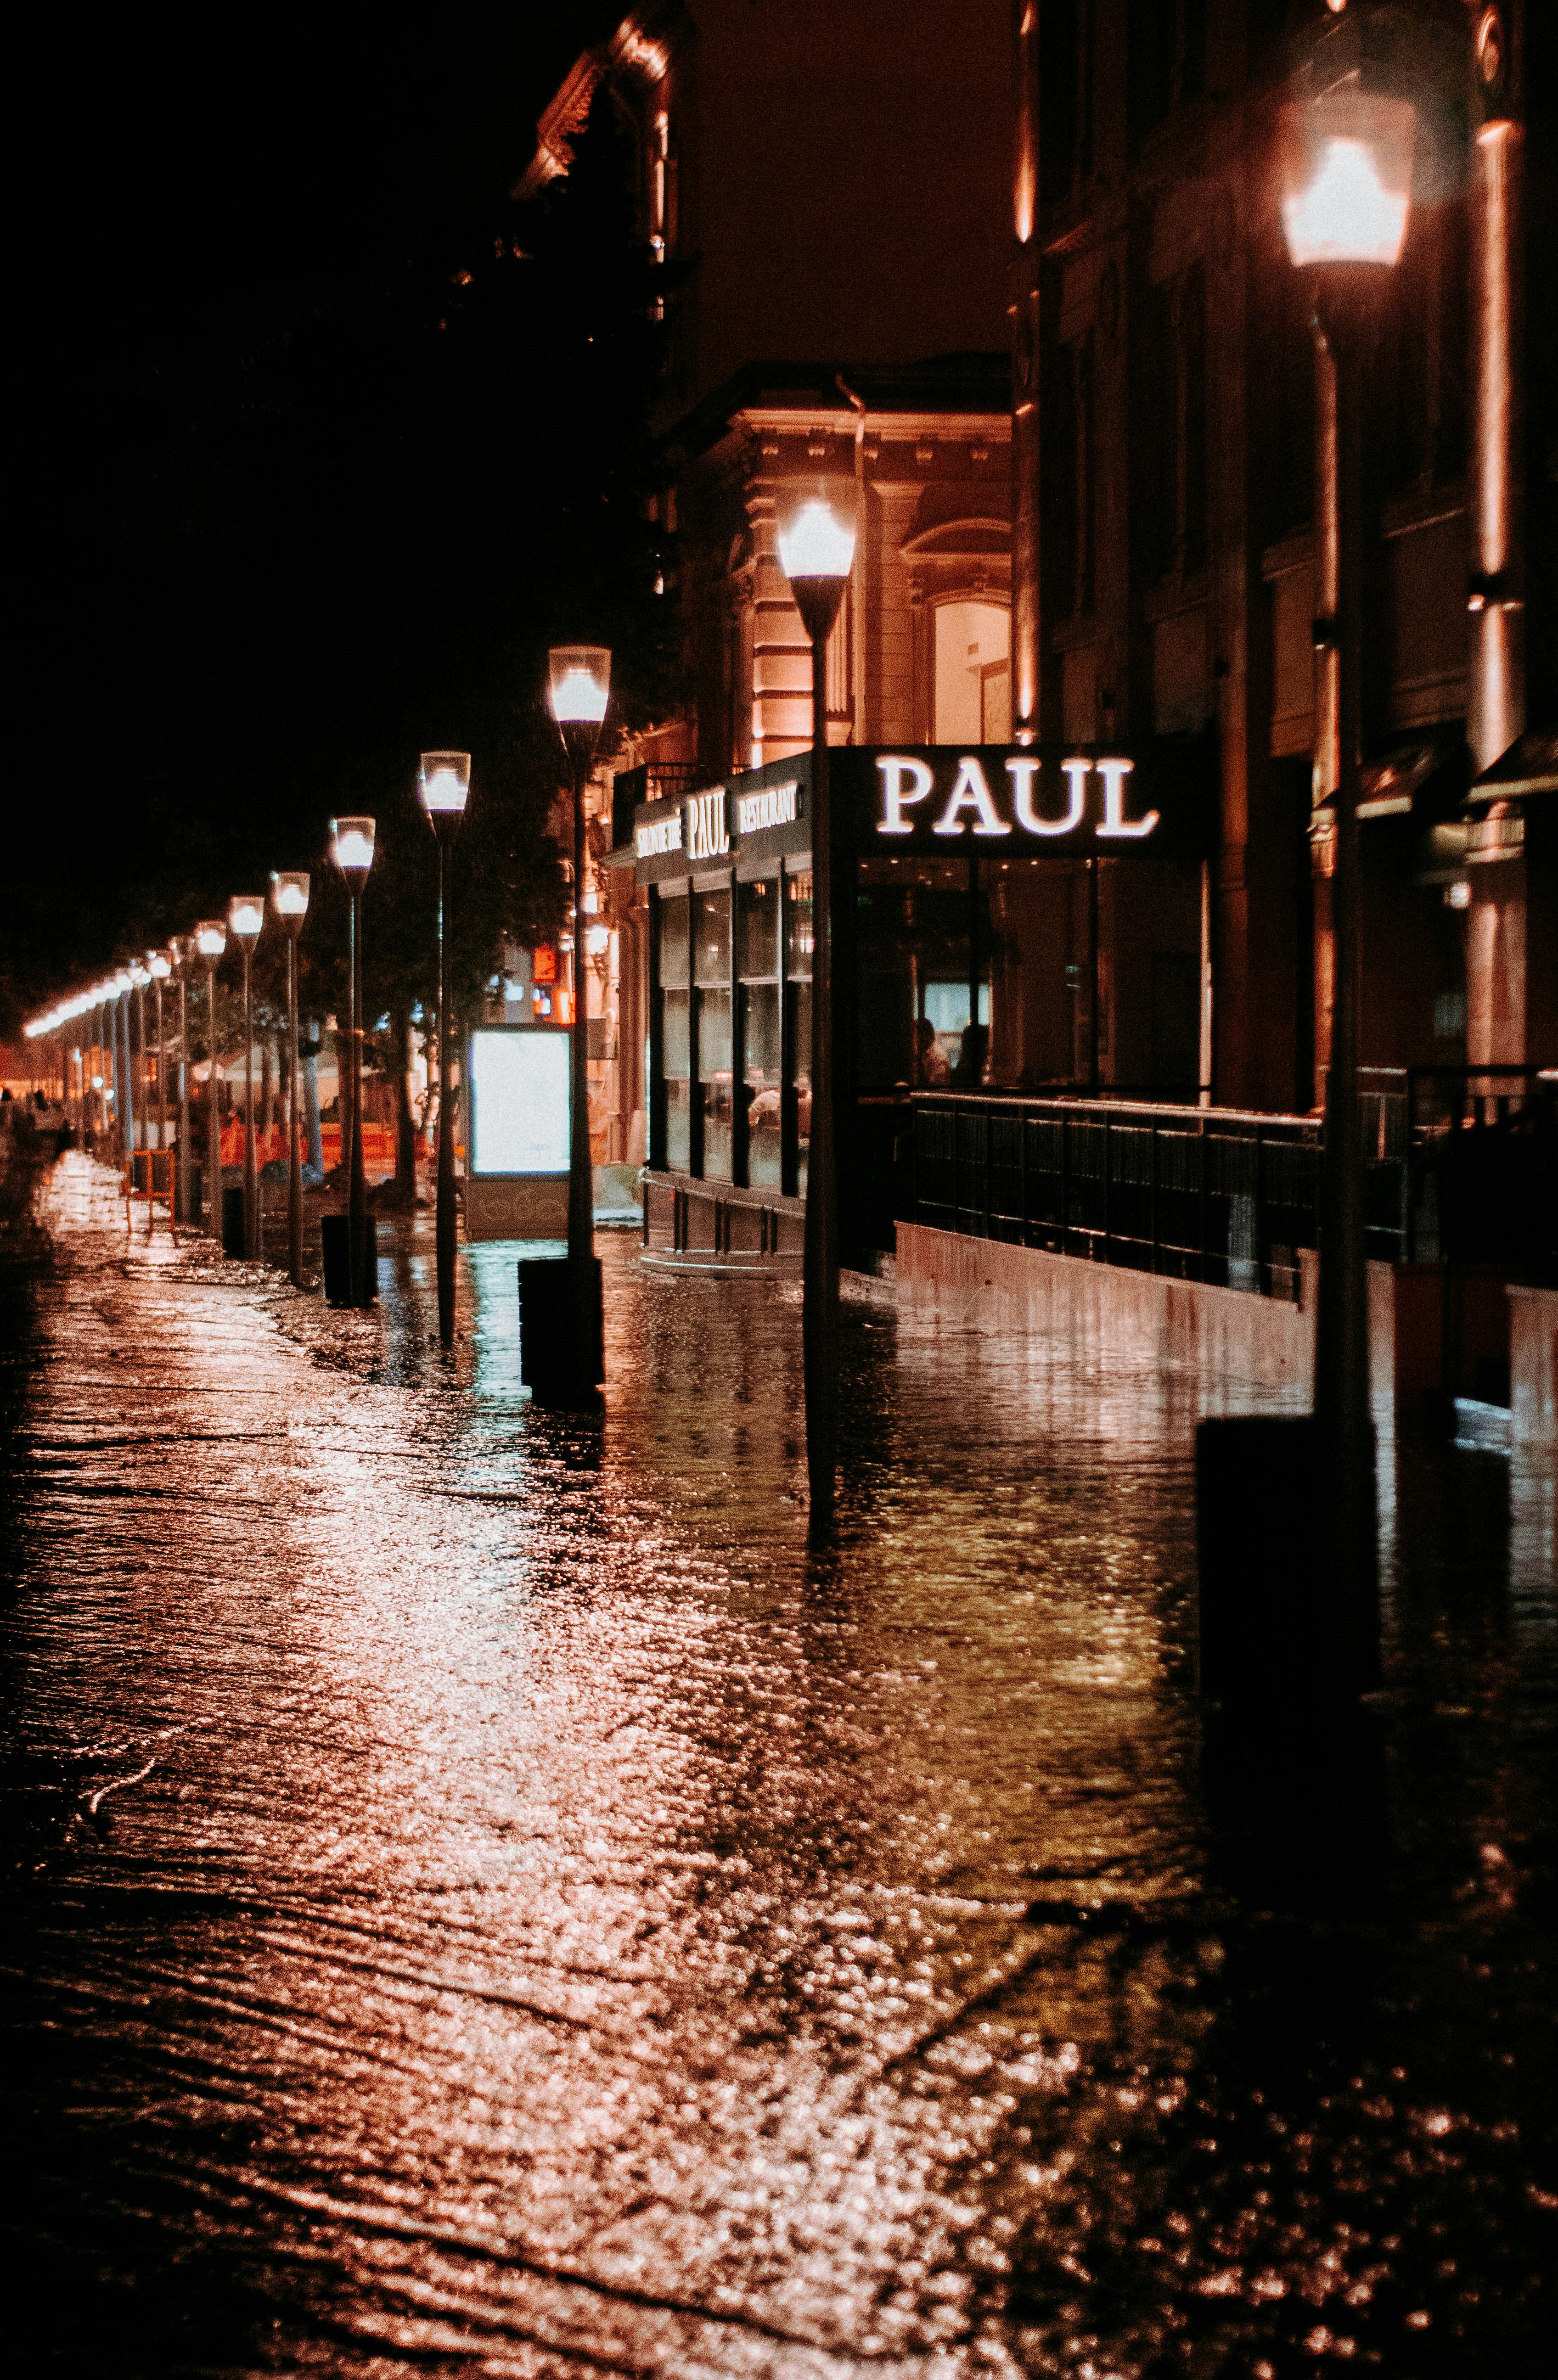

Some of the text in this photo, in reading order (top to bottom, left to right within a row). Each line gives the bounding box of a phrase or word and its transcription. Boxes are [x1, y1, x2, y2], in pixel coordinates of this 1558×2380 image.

[688, 790, 729, 859] PAUL
[738, 783, 797, 834] RESTAURANT
[876, 756, 1159, 836] PAUL
